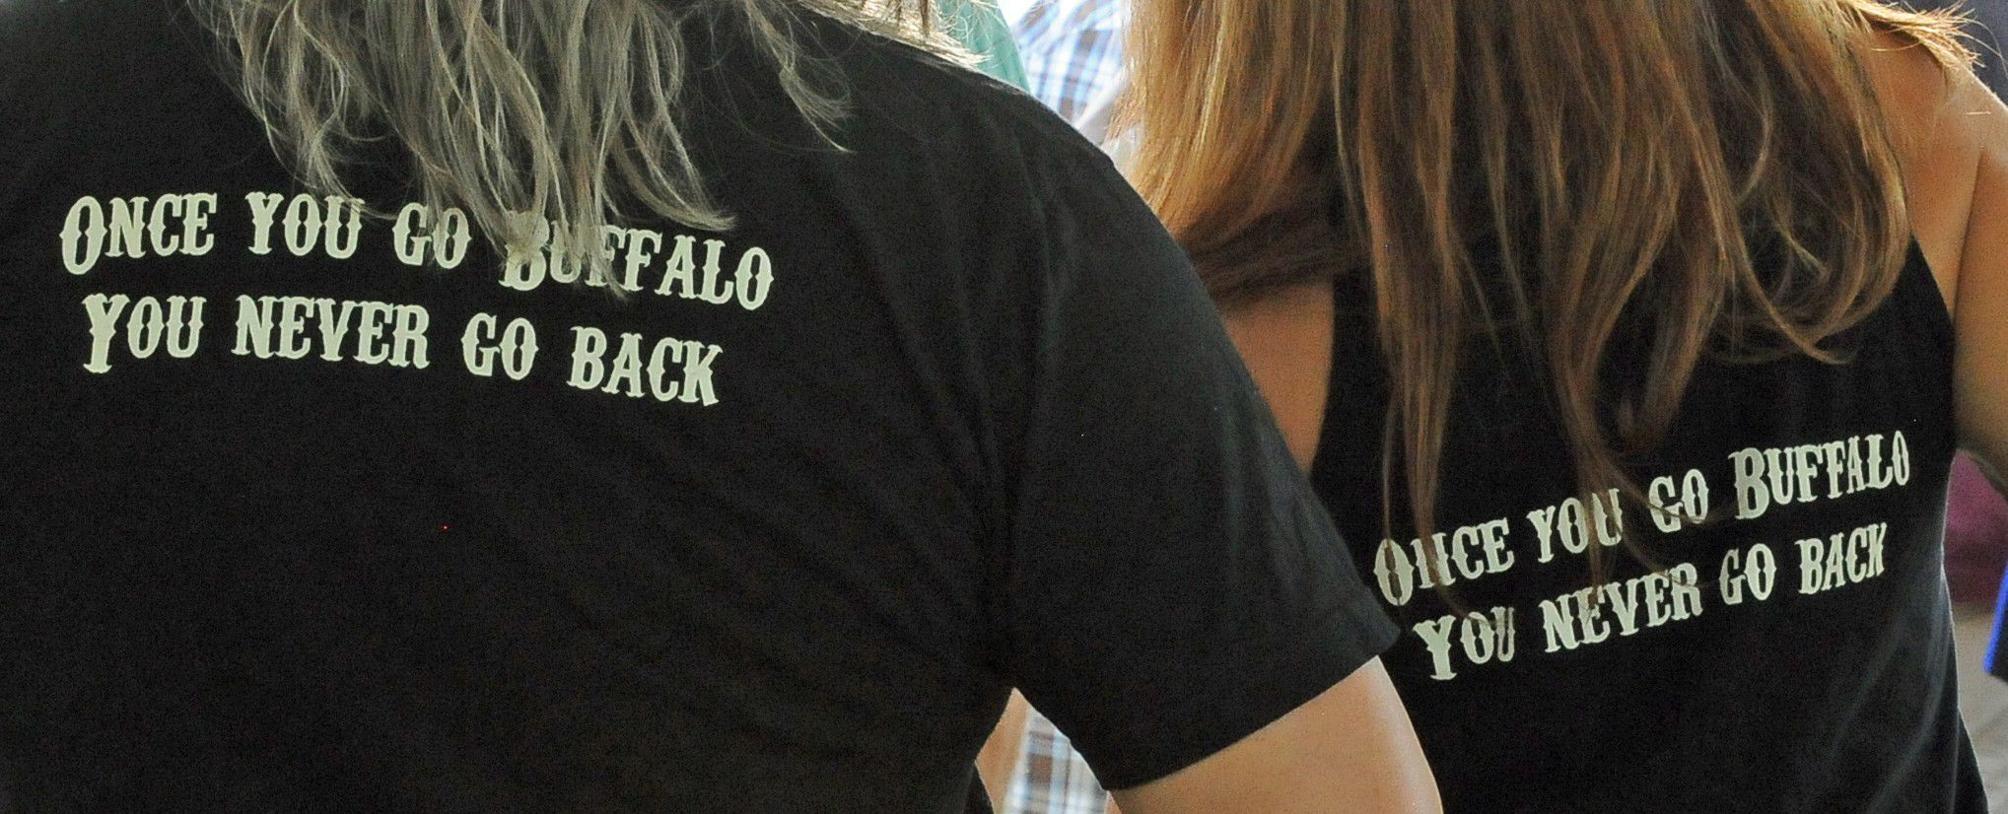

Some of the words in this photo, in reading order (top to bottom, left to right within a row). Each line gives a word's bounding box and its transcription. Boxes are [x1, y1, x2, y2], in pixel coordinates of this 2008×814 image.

[59, 193, 217, 275] ONCE
[244, 192, 365, 259] YOU
[392, 202, 472, 269] GO
[82, 293, 207, 374] YOU
[231, 294, 430, 369] NEVER
[460, 312, 539, 380] GO
[567, 326, 723, 406] BACK
[1374, 517, 1515, 606] ONCE
[1526, 488, 1623, 564] YOU
[1648, 468, 1709, 533] GO
[1728, 430, 1911, 520] BUFFALO
[1412, 606, 1516, 681] YOU
[1538, 562, 1704, 653] NEVER
[1718, 543, 1777, 605] GO
[1794, 522, 1888, 595] BACK
